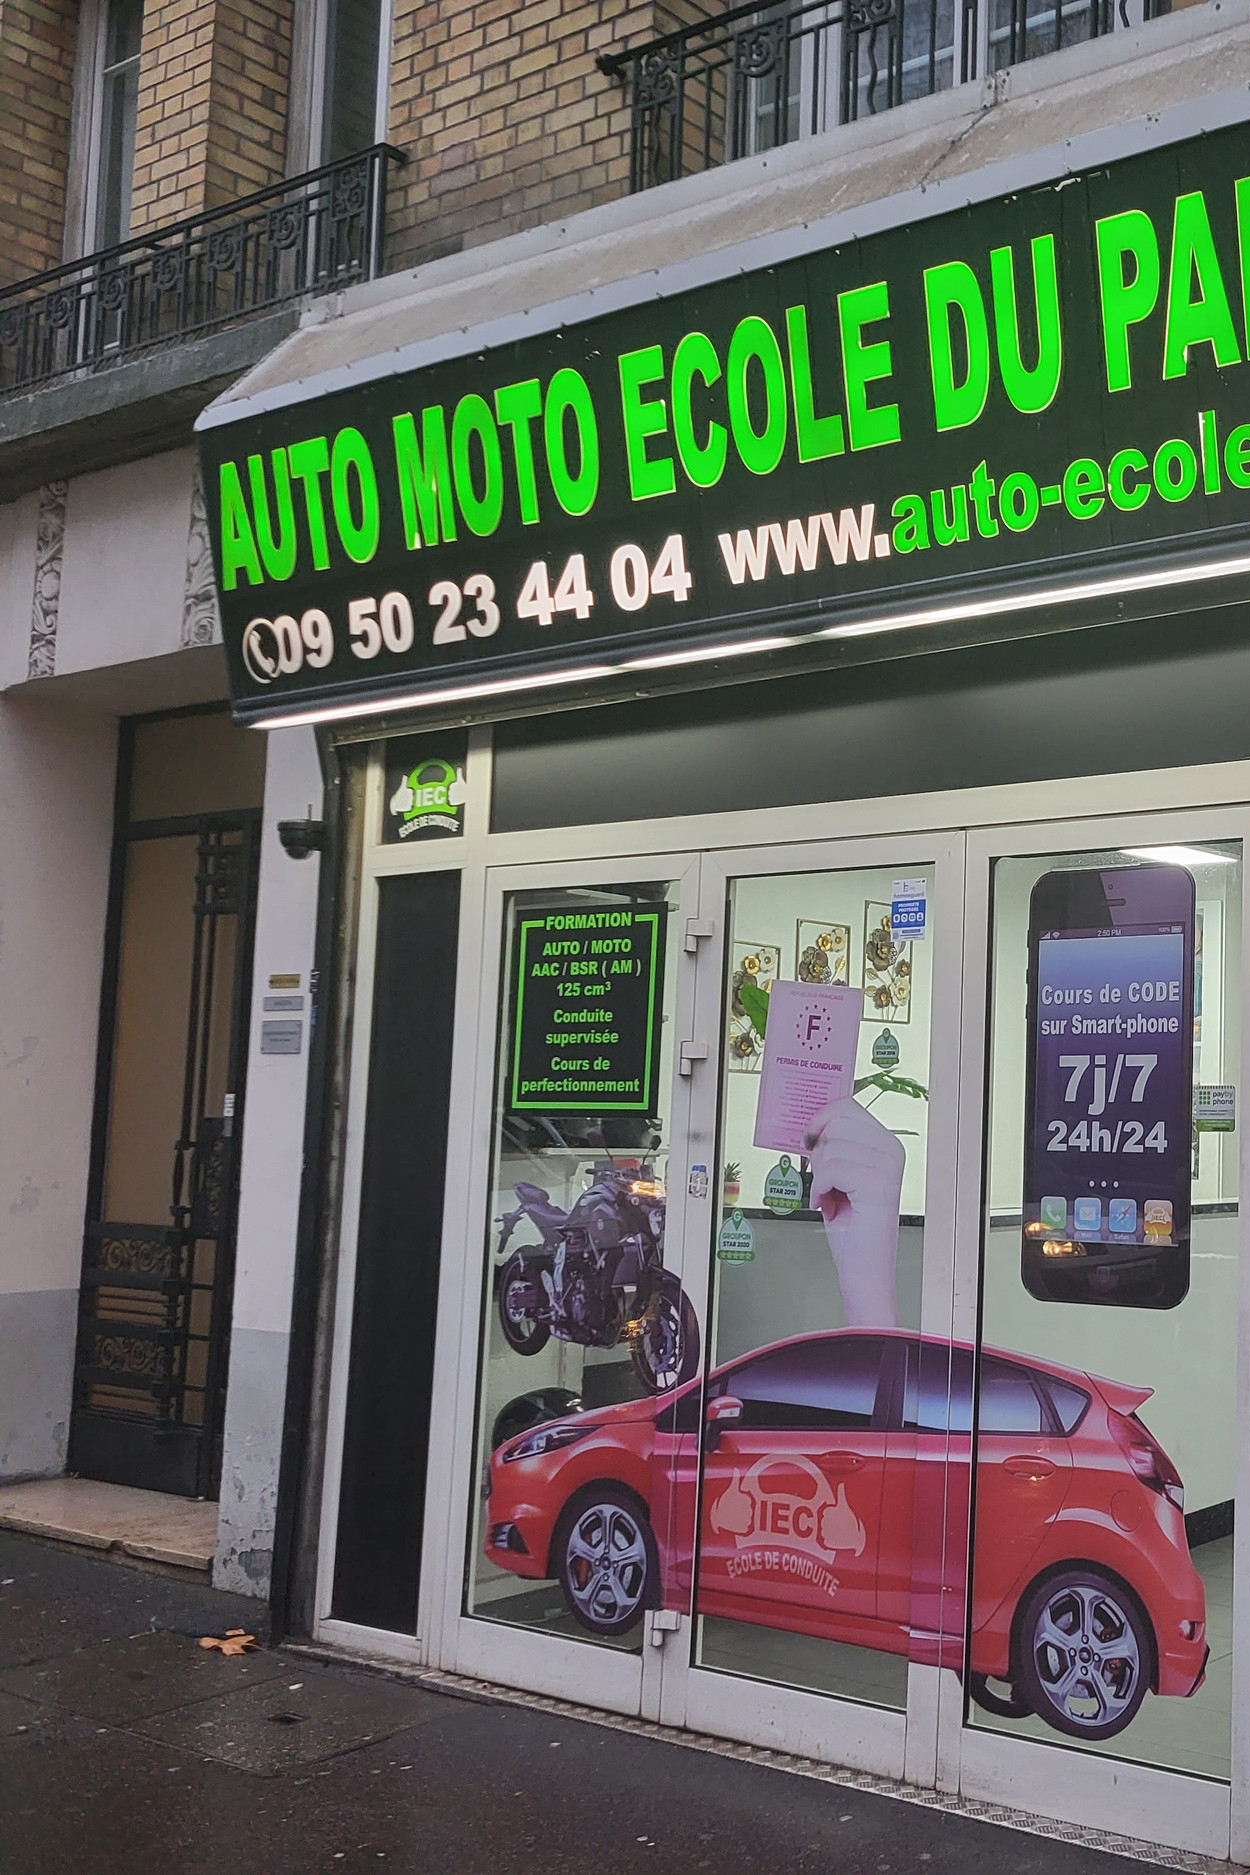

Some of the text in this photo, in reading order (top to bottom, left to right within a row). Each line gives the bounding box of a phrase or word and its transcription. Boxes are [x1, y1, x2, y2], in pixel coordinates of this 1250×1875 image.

[220, 427, 379, 591] AUTO
[392, 368, 599, 551] MOTO
[618, 281, 901, 501] ECOLE
[923, 234, 1062, 432] DU
[273, 608, 332, 675] 09
[348, 593, 414, 660] 50
[428, 574, 500, 645] 23
[517, 554, 593, 625] 44
[610, 534, 692, 611] 04
[416, 786, 447, 807] IEC
[546, 912, 632, 930] FORMATION
[543, 941, 580, 956] AUTO
[591, 938, 632, 954] MOTO
[531, 963, 559, 977] AAC
[570, 961, 598, 976] BSR
[610, 959, 632, 974] AM
[557, 983, 580, 996] 125
[1041, 981, 1180, 1005] Cours de CODE
[553, 1009, 613, 1023] Conduite
[806, 1014, 822, 1041] F
[1041, 1013, 1179, 1038] sur Smart-phone
[545, 1029, 619, 1047] supervisée
[551, 1056, 610, 1071] Cours de
[776, 1056, 843, 1072] PERMIS DE CONDUIRE
[521, 1078, 640, 1094] perfectionnement
[1059, 1054, 1158, 1116] 7j/7
[1212, 1098, 1233, 1106] phone
[1046, 1120, 1168, 1154] 24h/24
[769, 1178, 799, 1188] GROUPON
[769, 1187, 783, 1195] STAR
[722, 1232, 752, 1240] GROUPON
[759, 1500, 814, 1539] IEC
[726, 1551, 840, 1597] ECOLE DE CONDUITE
